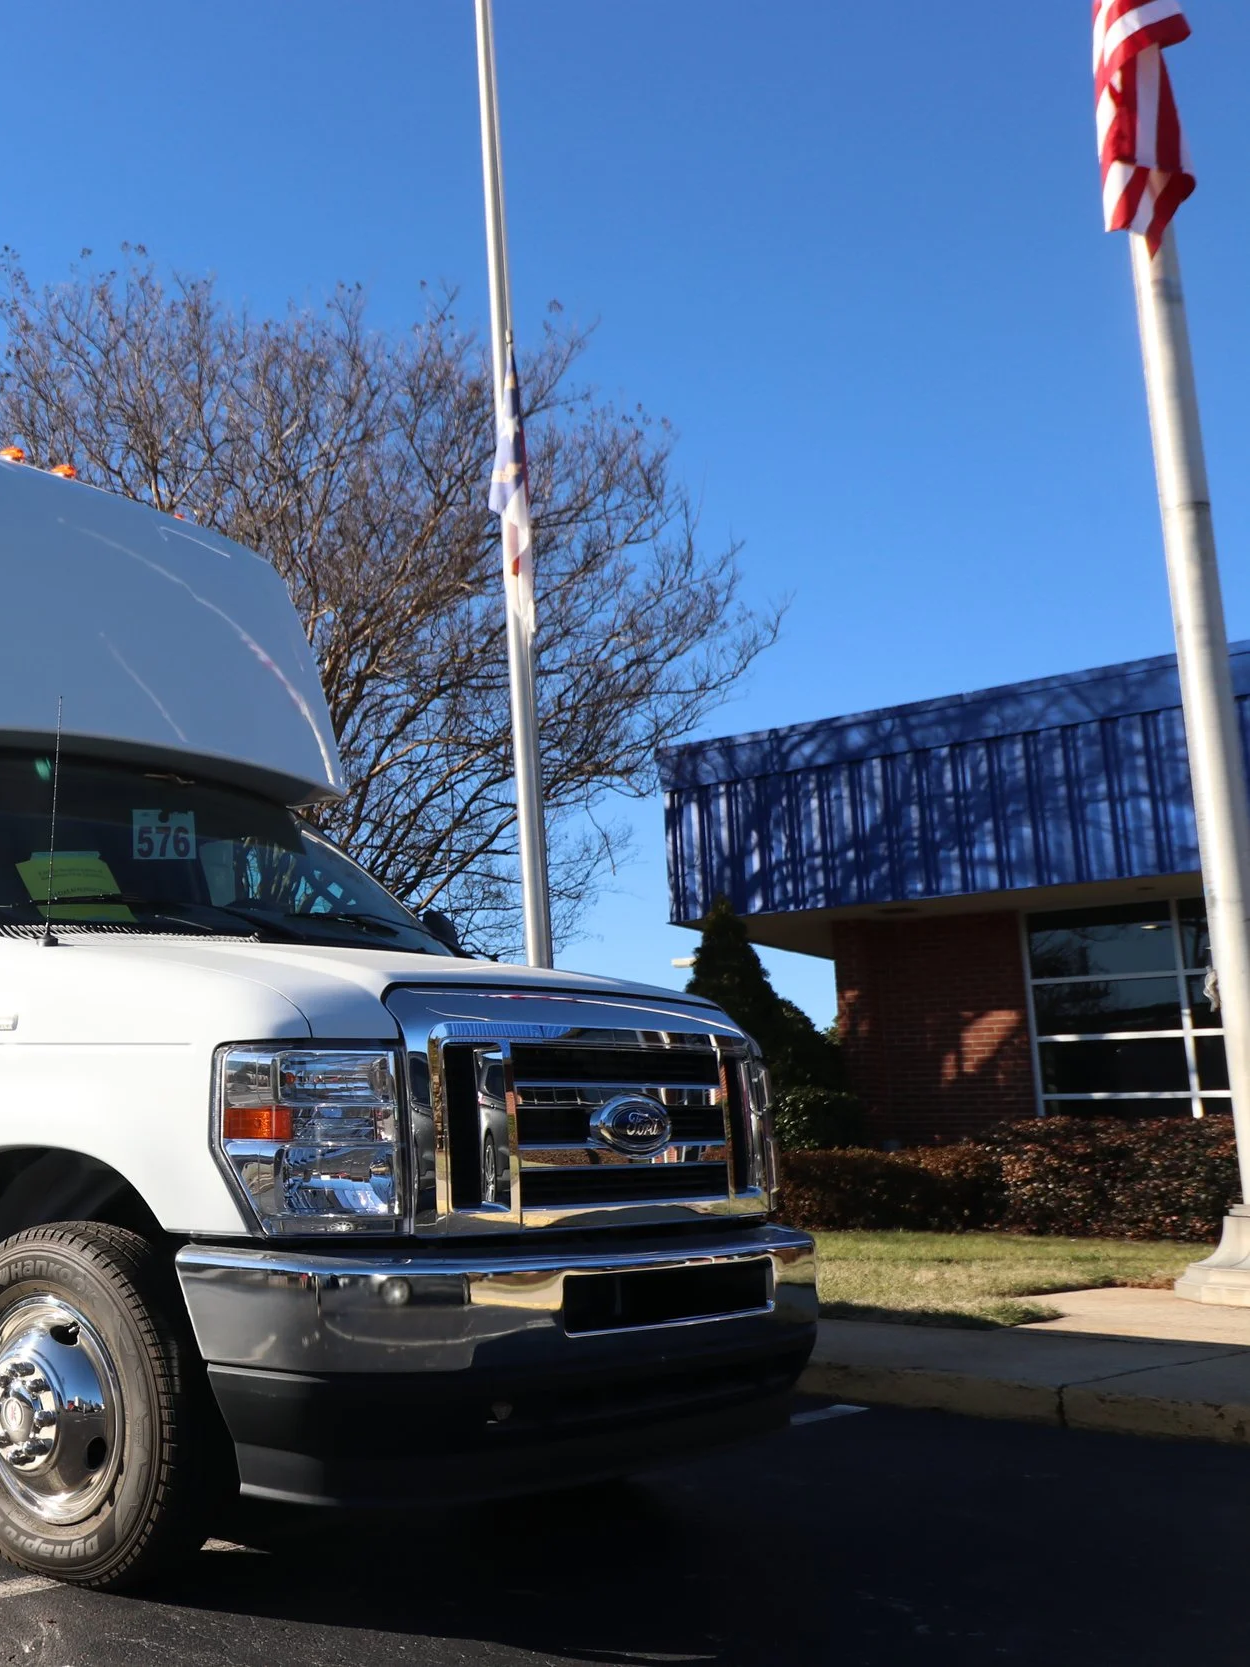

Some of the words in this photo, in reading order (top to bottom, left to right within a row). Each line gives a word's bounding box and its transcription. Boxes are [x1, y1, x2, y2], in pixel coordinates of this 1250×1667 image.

[137, 826, 190, 858] 576
[626, 1111, 658, 1136] Ford
[3, 1525, 99, 1559] Dynapro
